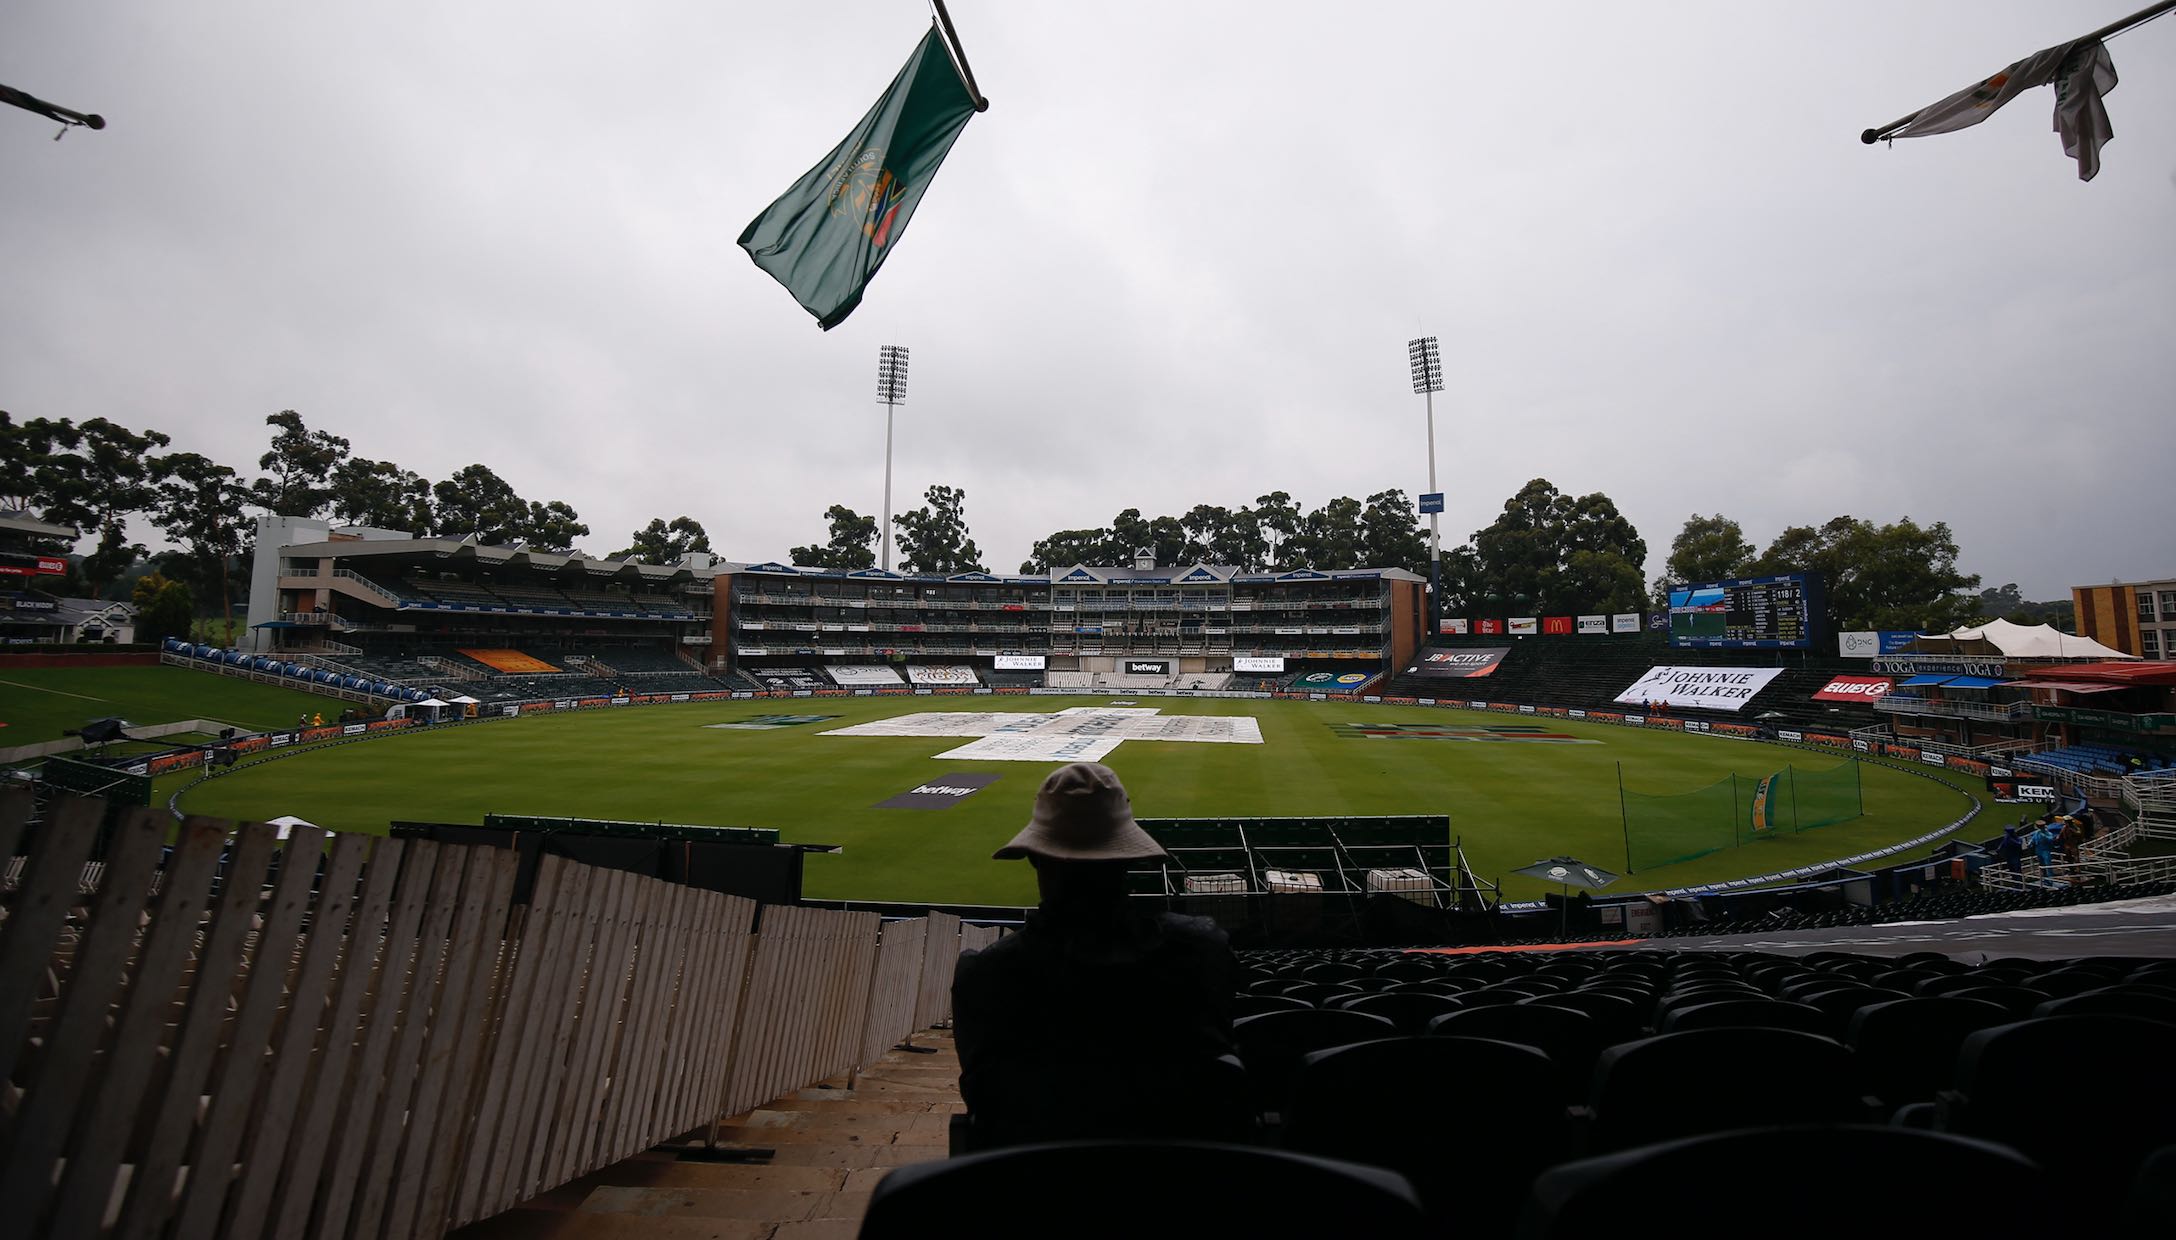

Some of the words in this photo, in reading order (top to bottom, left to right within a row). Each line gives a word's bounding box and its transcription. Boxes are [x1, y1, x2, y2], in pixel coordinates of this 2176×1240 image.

[1132, 662, 1162, 673] betway
[1885, 662, 1916, 673] YOGA
[1963, 663, 1991, 676] YOGA
[1660, 670, 1755, 685] JOHNNIE
[1670, 684, 1753, 699] WALKER
[911, 784, 977, 796] betway
